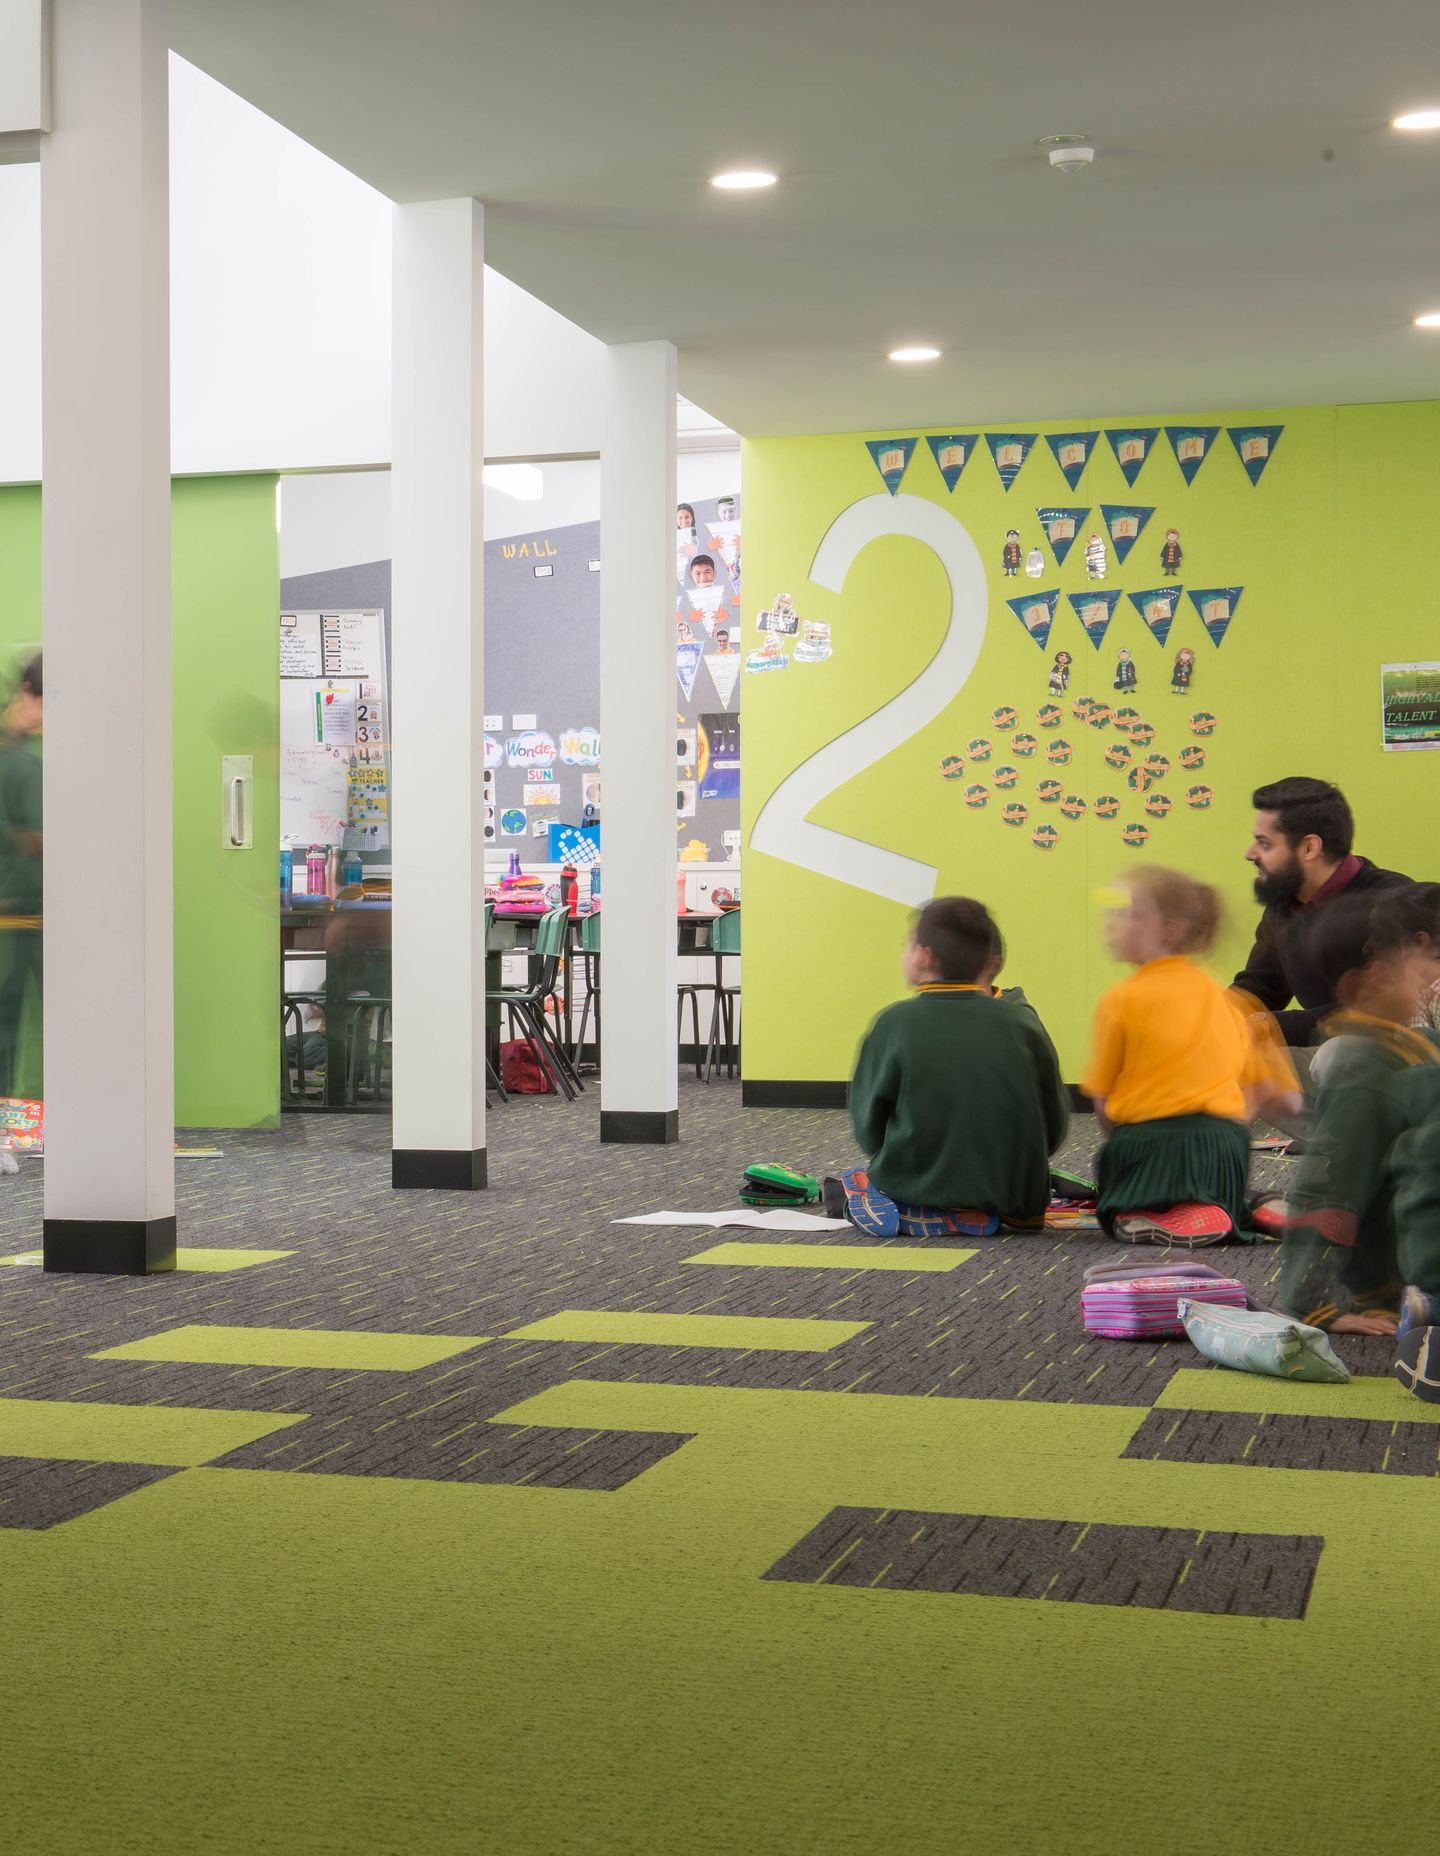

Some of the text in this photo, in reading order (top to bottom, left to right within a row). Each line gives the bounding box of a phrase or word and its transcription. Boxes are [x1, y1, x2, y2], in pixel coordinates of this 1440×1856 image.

[502, 540, 558, 559] WALL
[749, 493, 988, 909] 2
[357, 705, 368, 721] 2
[1386, 710, 1437, 722] TALENT
[358, 726, 369, 743] 3
[359, 747, 371, 764] 4
[506, 740, 556, 758] Wonder
[562, 738, 600, 757] Wal
[528, 769, 553, 780] SUN
